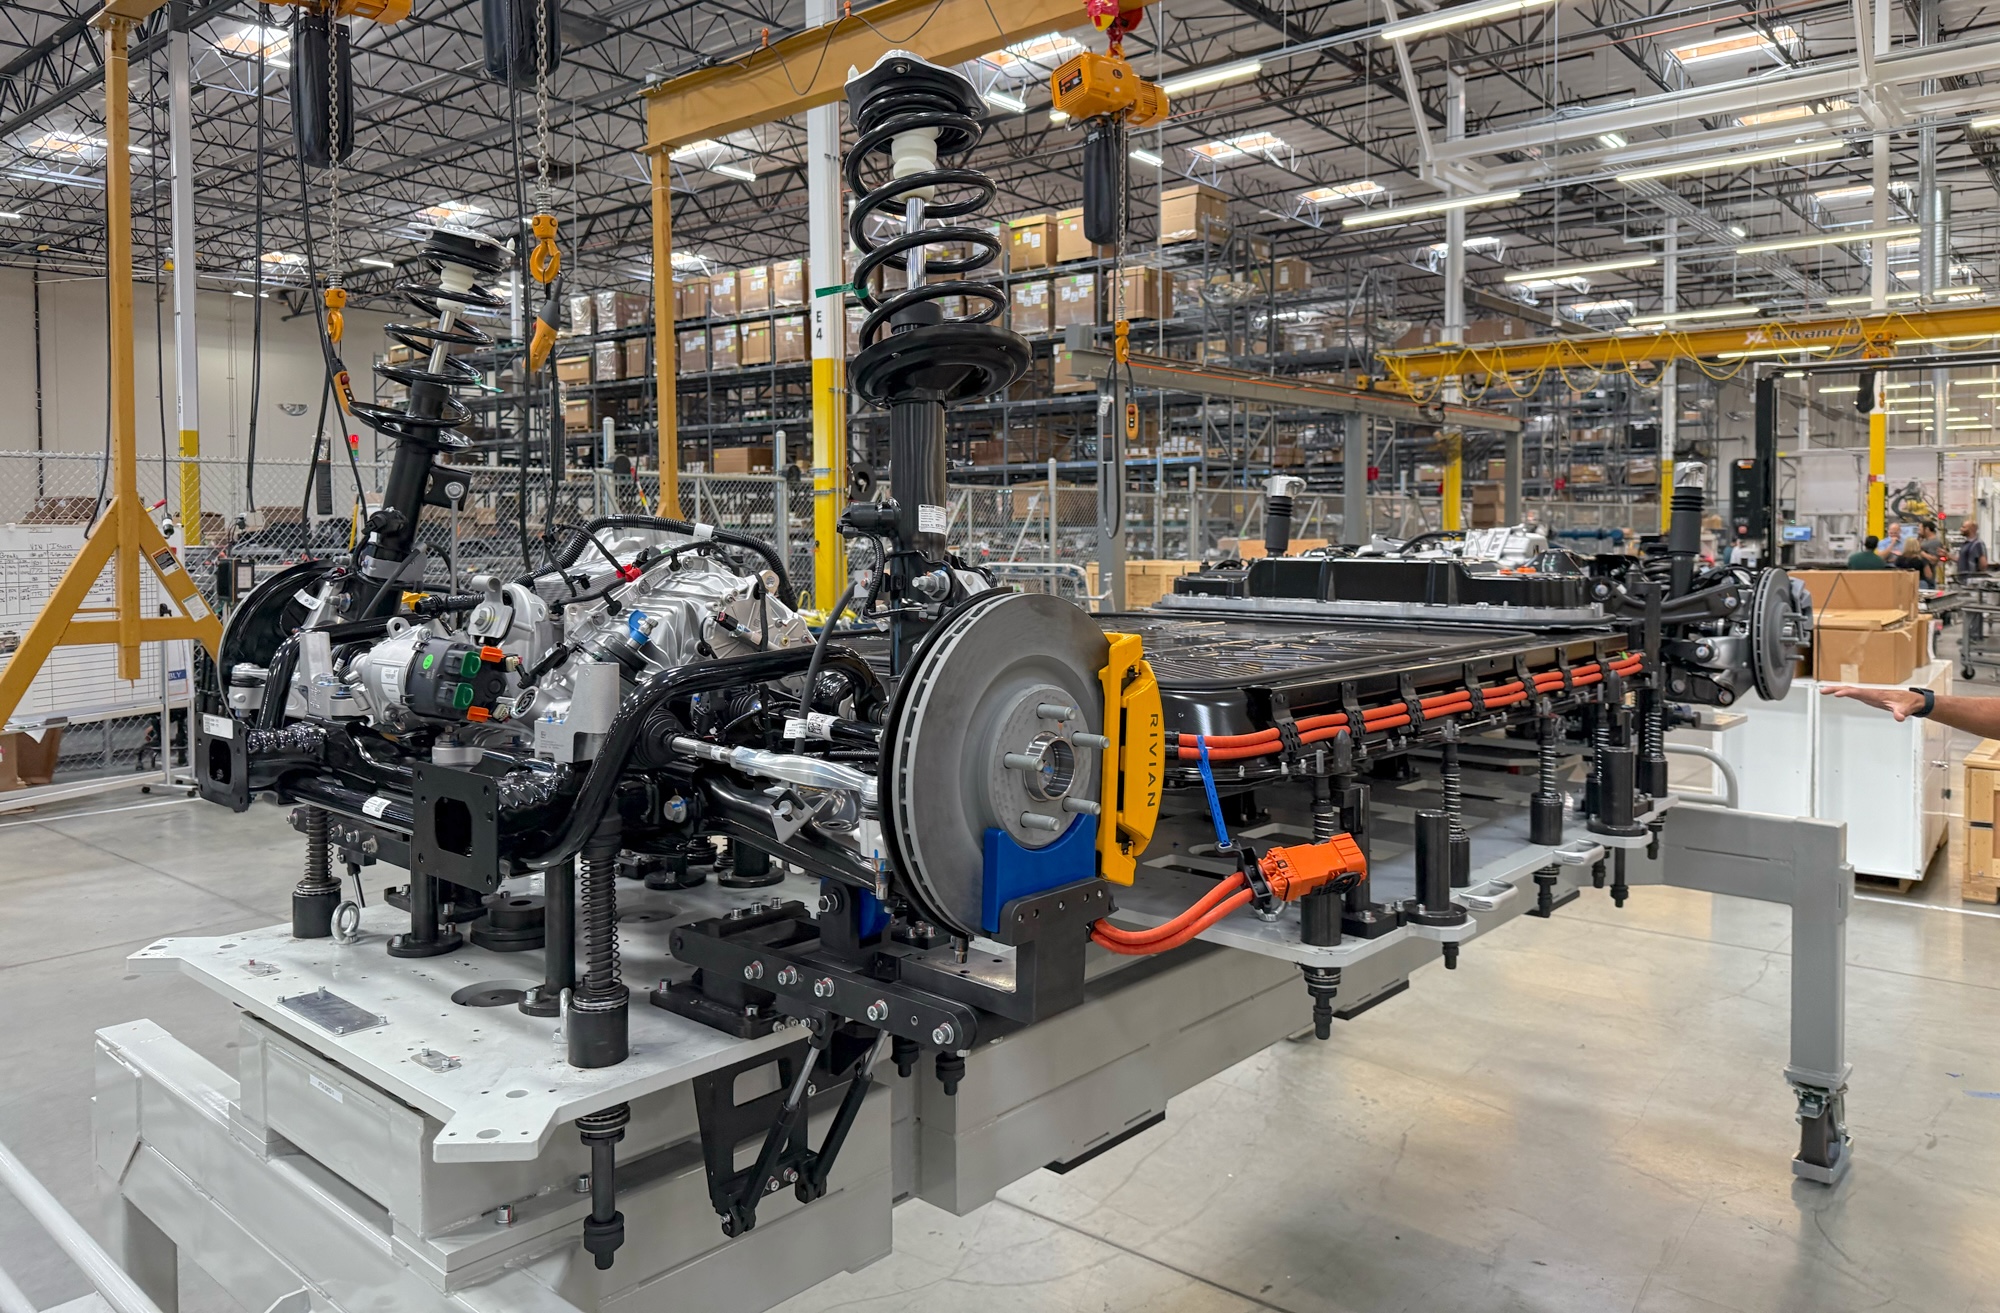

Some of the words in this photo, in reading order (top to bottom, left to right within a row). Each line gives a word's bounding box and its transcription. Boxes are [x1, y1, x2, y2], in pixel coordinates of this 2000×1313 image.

[816, 310, 822, 323] E
[815, 327, 823, 340] 4
[1147, 714, 1159, 807] RIVIAN
